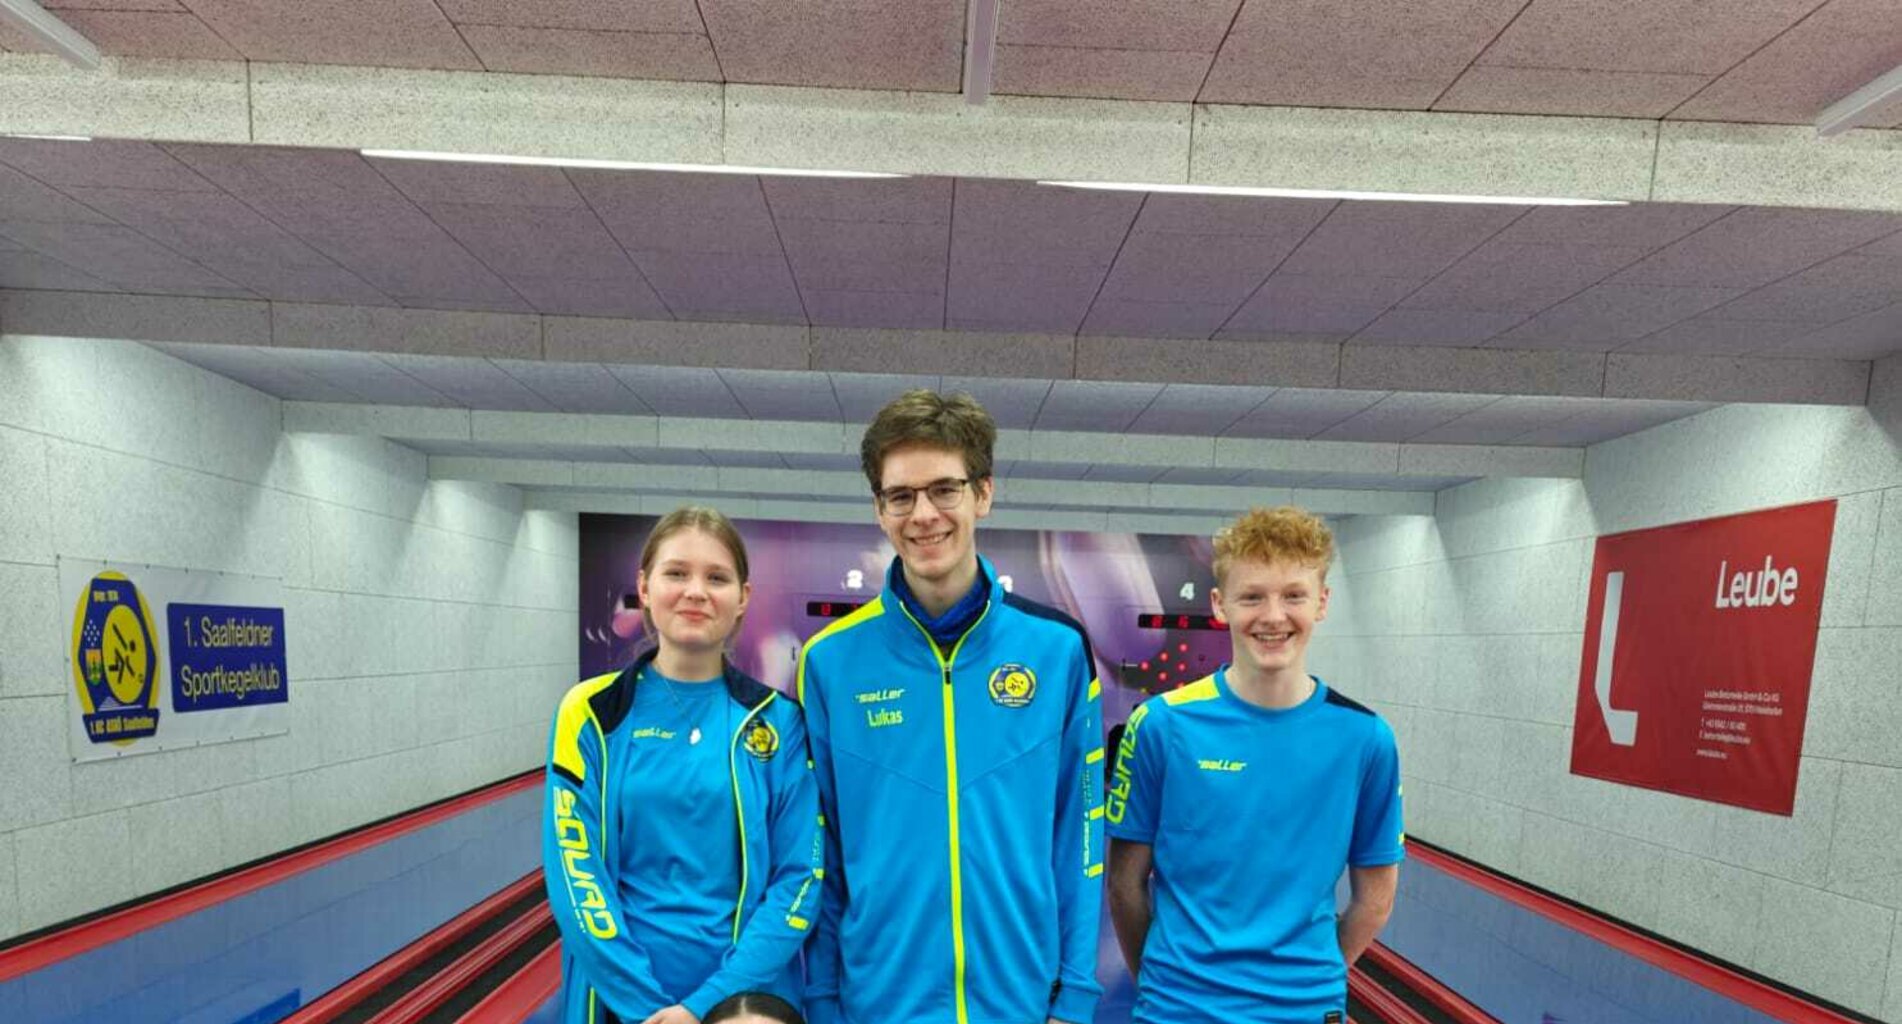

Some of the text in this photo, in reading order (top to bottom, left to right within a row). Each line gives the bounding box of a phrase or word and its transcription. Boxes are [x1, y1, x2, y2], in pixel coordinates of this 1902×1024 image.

[847, 569, 863, 589] 2
[1179, 582, 1194, 600] 4
[1715, 555, 1799, 609] Leube
[184, 616, 275, 648] 1. Saalfeldner
[181, 662, 281, 704] Sportkegelklub
[867, 708, 903, 727] Lukas
